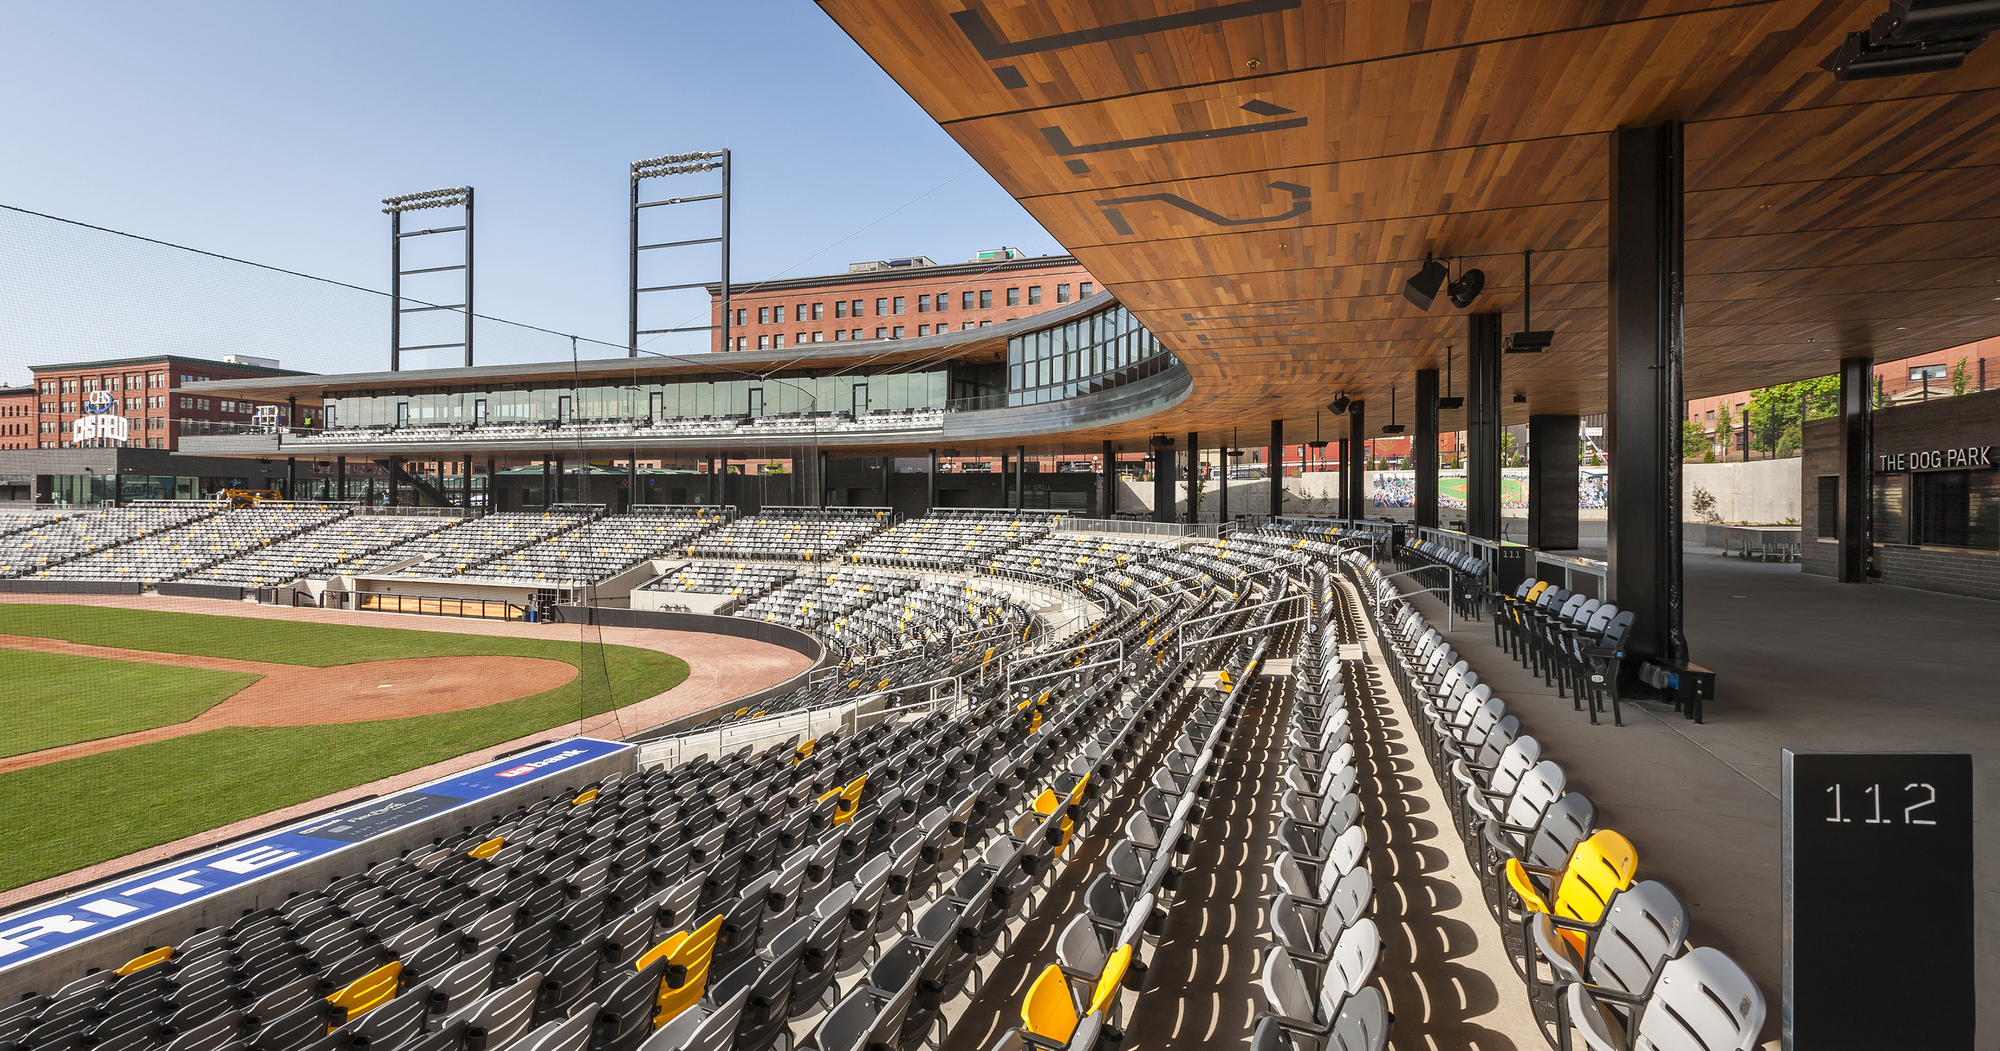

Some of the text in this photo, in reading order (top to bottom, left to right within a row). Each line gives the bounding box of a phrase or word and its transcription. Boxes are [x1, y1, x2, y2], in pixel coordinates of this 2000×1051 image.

[90, 390, 110, 404] CHS
[73, 414, 128, 442] CHS FIELD
[1880, 446, 1990, 471] THE DOG PARK
[1503, 550, 1521, 559] 111
[1825, 783, 1937, 825] 112
[0, 845, 300, 957] RITE
